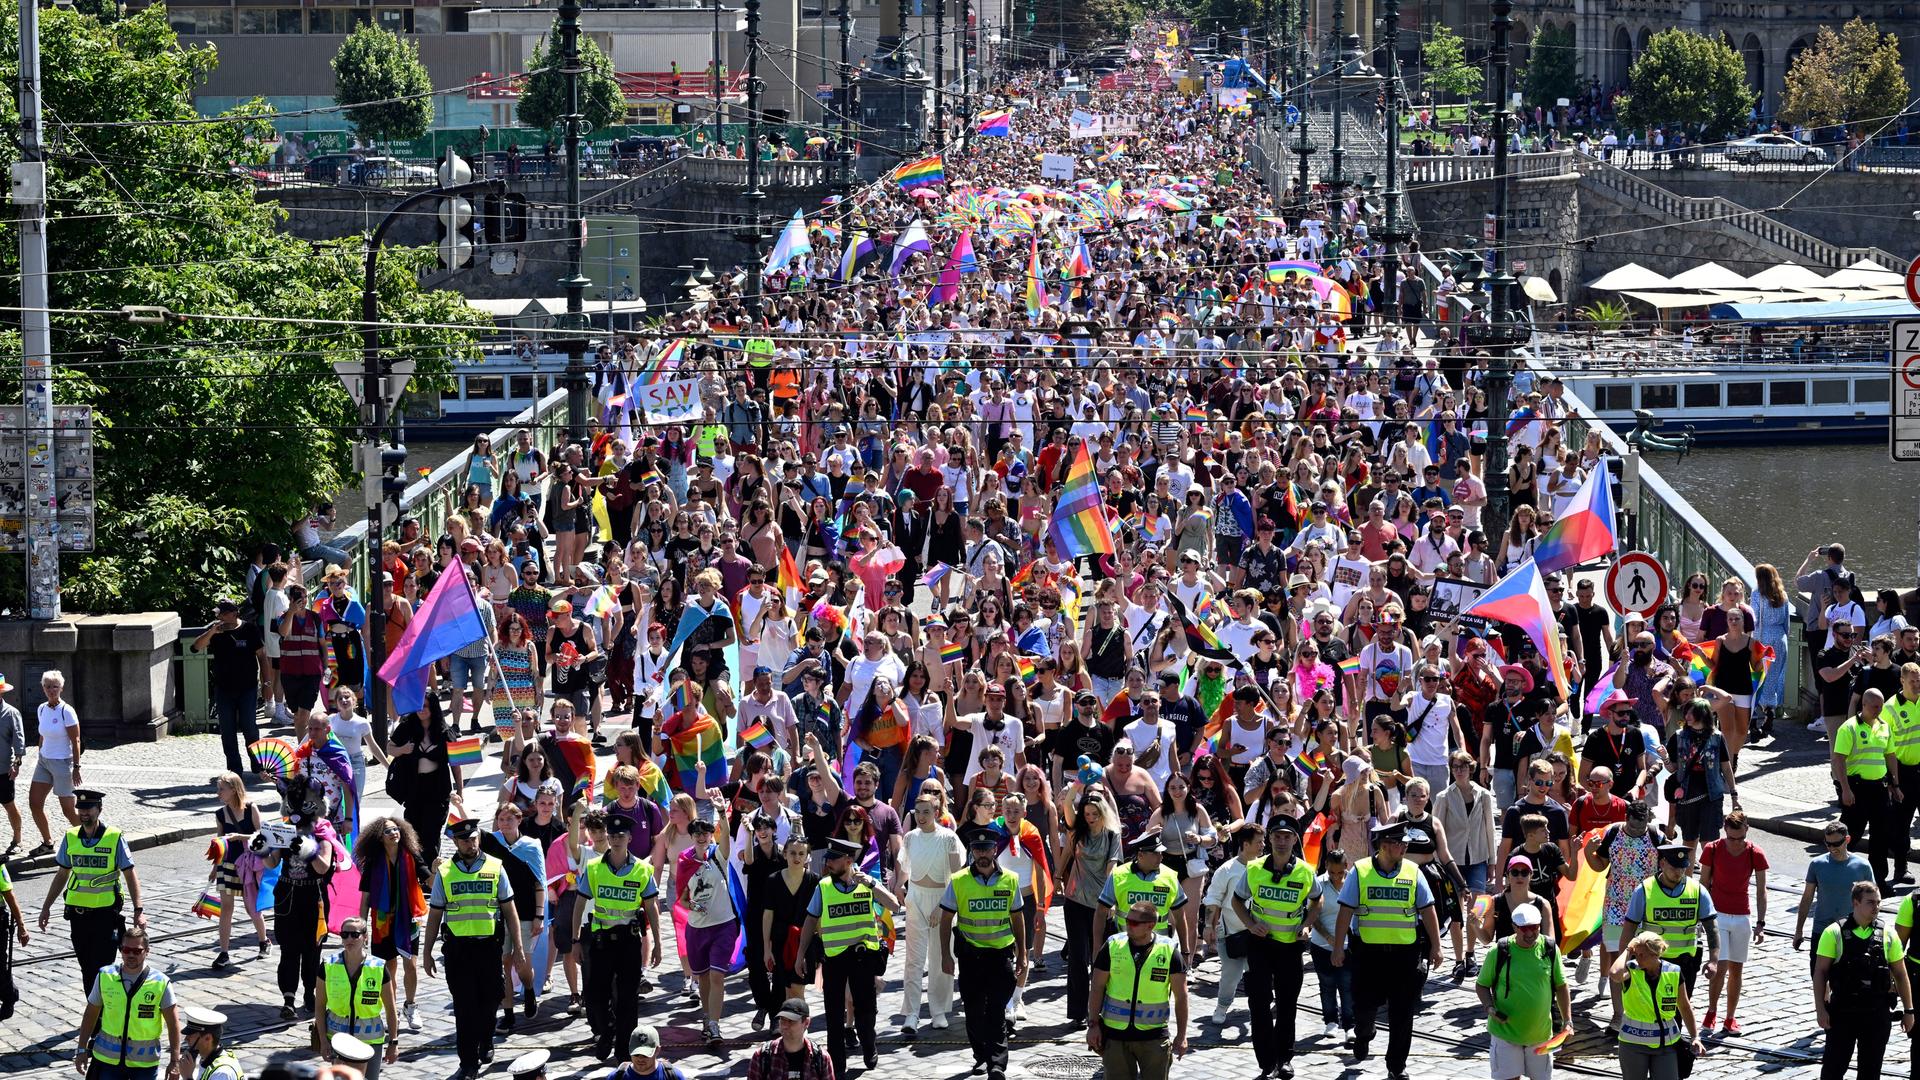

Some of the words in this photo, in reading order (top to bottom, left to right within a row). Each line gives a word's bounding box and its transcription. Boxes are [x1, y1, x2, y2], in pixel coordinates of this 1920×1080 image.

[649, 383, 692, 408] SAY
[452, 882, 492, 893] POLICIE
[598, 887, 636, 900] POLICIE
[1259, 887, 1298, 902] POLICIE
[1368, 888, 1409, 900] POLICIE
[829, 903, 870, 917] POLICIE
[969, 899, 1007, 911] POLICIE
[1654, 909, 1695, 919] POLICIE
[1626, 1027, 1655, 1037] POLICIE
